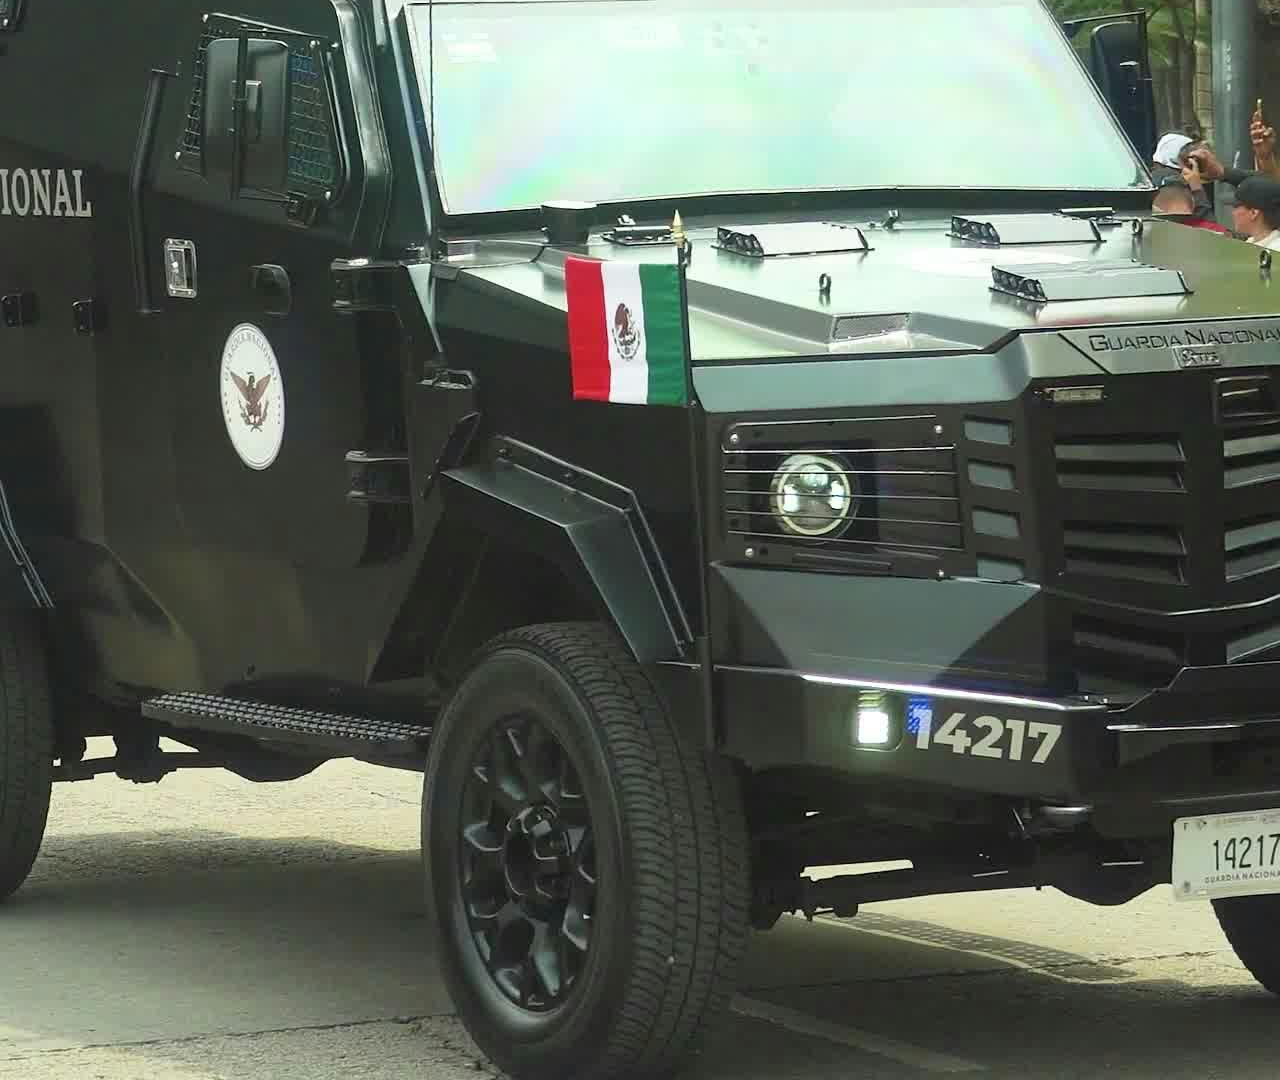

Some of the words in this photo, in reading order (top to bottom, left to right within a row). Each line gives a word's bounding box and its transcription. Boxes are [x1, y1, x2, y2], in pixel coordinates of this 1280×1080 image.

[1088, 334, 1184, 352] GUARDIA
[912, 708, 1063, 764] 14217
[1204, 873, 1241, 884] GUARDIA
